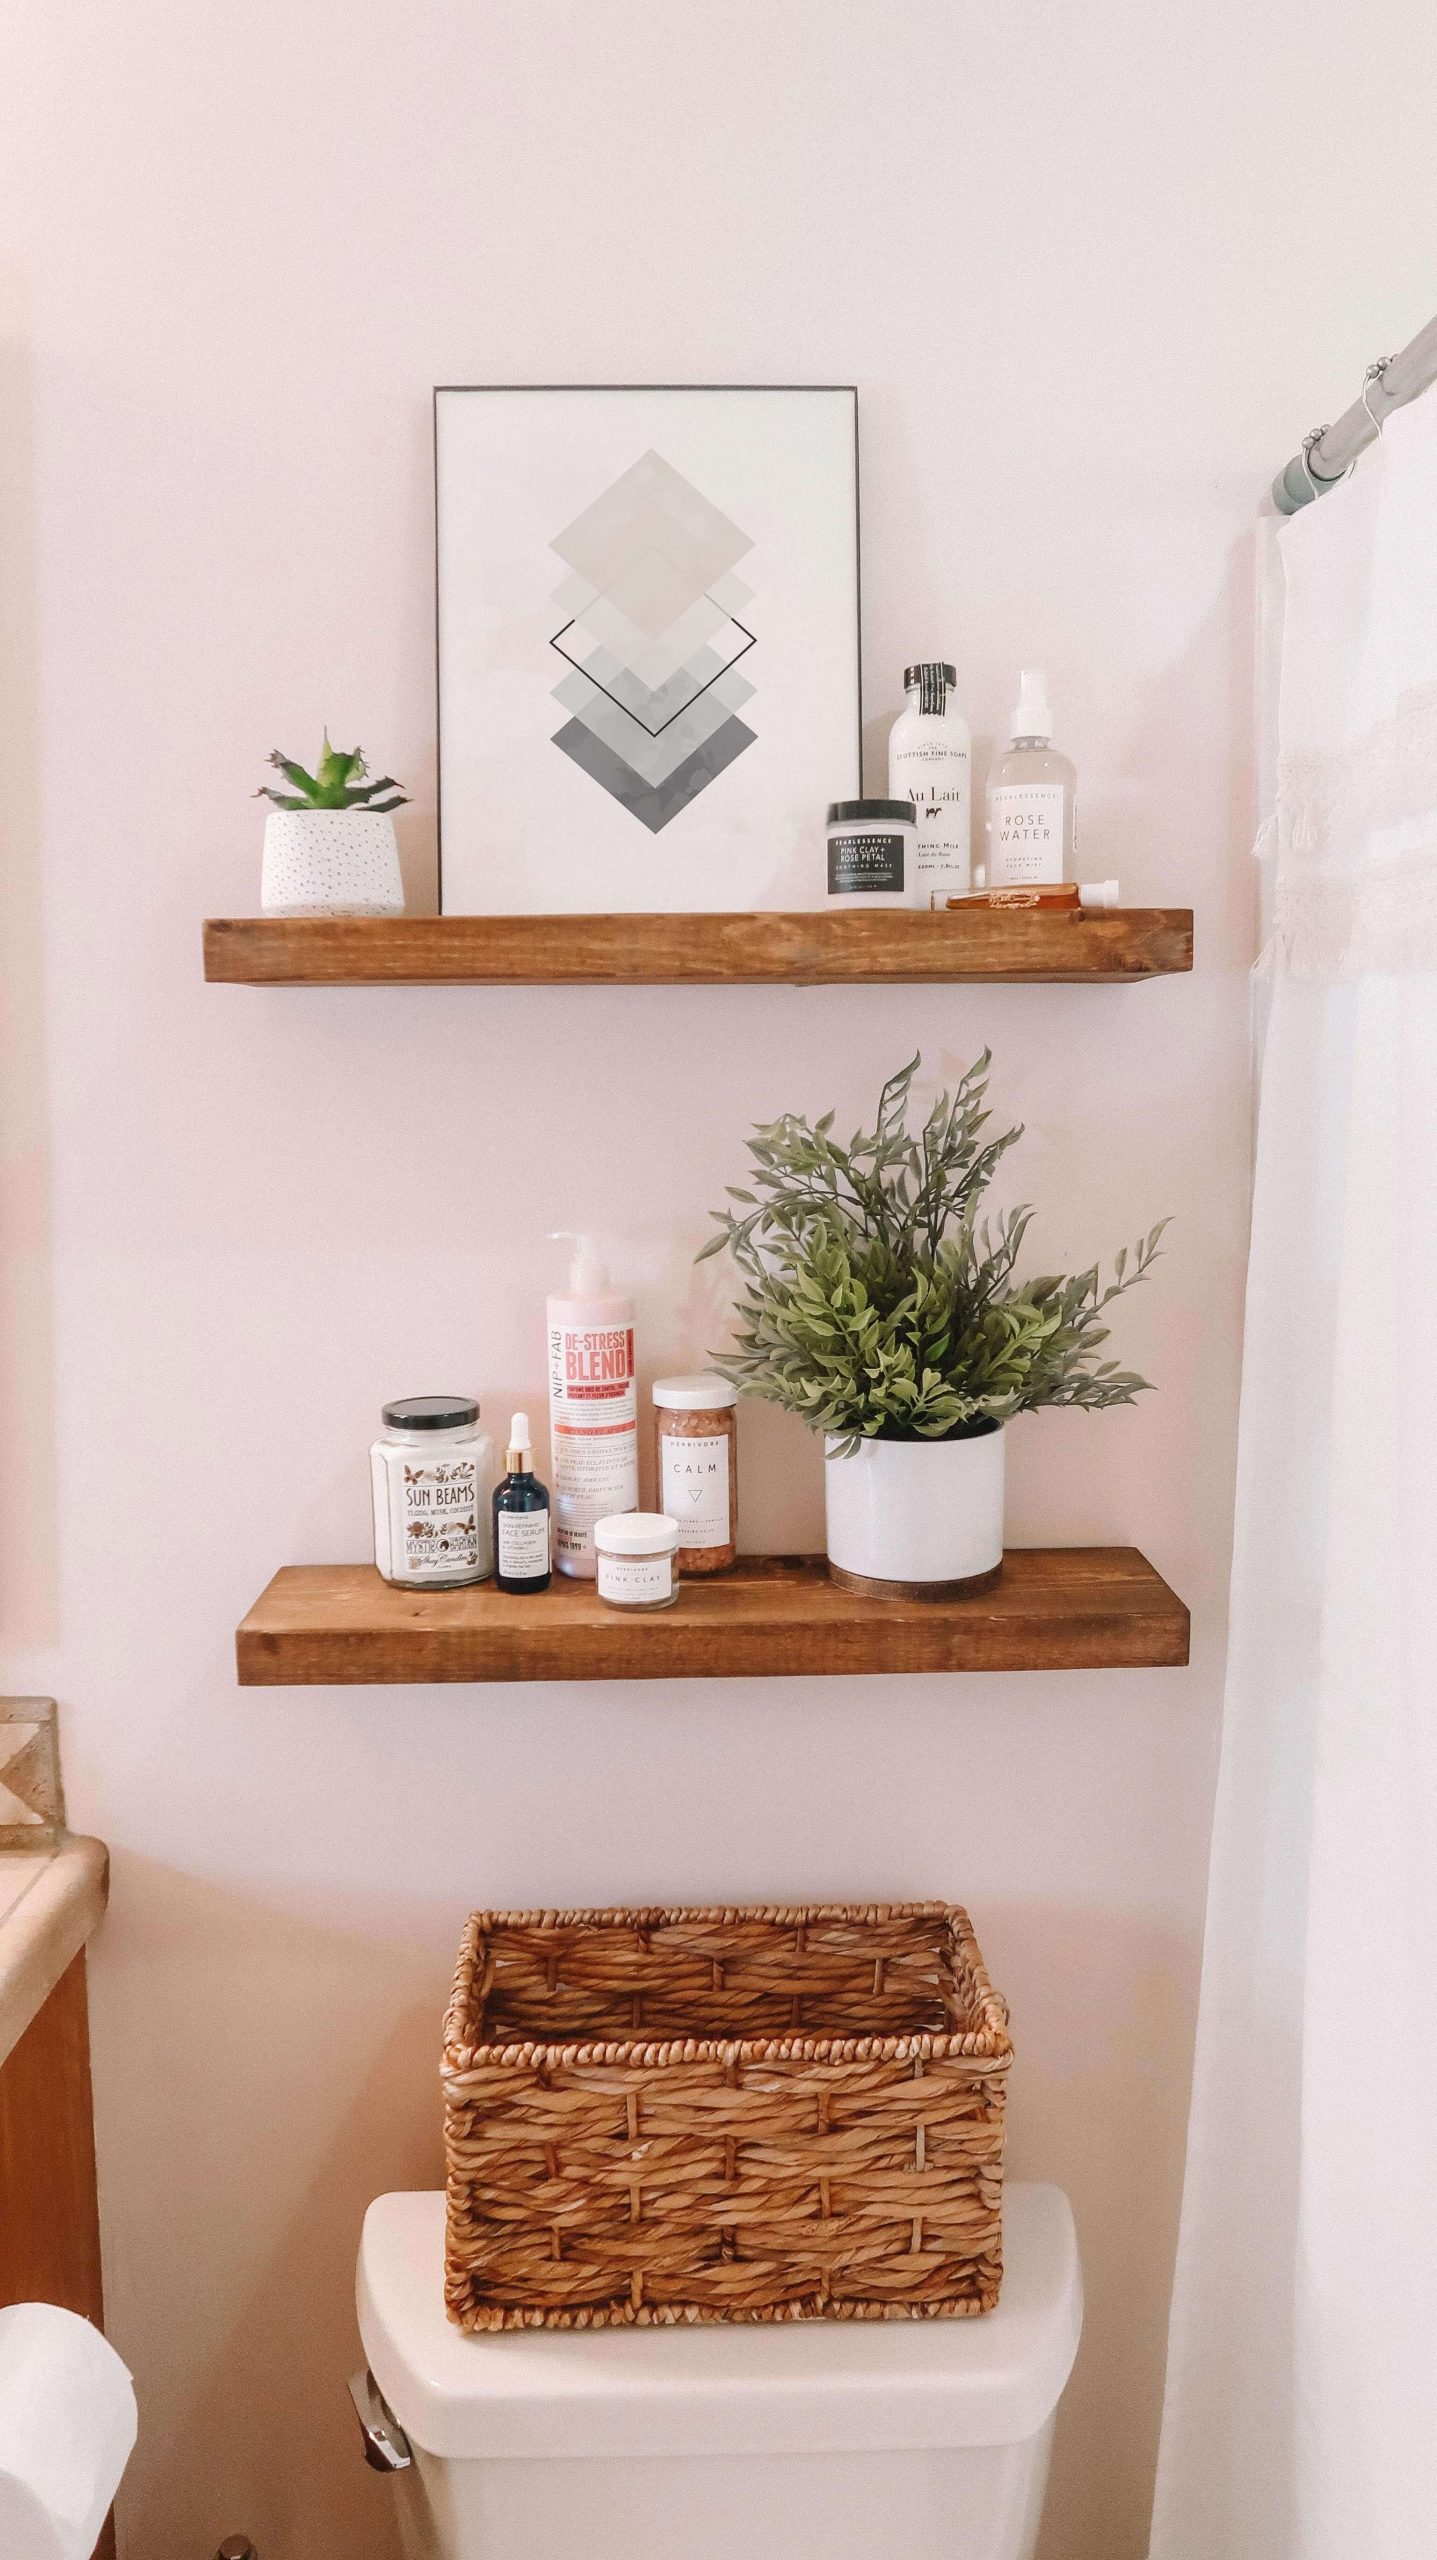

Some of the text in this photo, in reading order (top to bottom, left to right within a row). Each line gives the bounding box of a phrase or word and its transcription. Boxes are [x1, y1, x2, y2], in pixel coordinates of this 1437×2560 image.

[897, 751, 928, 760] SCOTTISH
[907, 786, 961, 802] Au Lait
[1005, 814, 1044, 825] ROSE
[1000, 829, 1050, 841] WATER
[835, 838, 892, 846] FEARLESSENCE
[840, 853, 885, 862] ROSE PETAL
[565, 1331, 625, 1350] DE-STRESS
[566, 1349, 626, 1380] BLEND
[673, 1464, 716, 1474] CALM
[406, 1482, 475, 1506] SUN BEAMS
[502, 1527, 545, 1537] FACE SERUM
